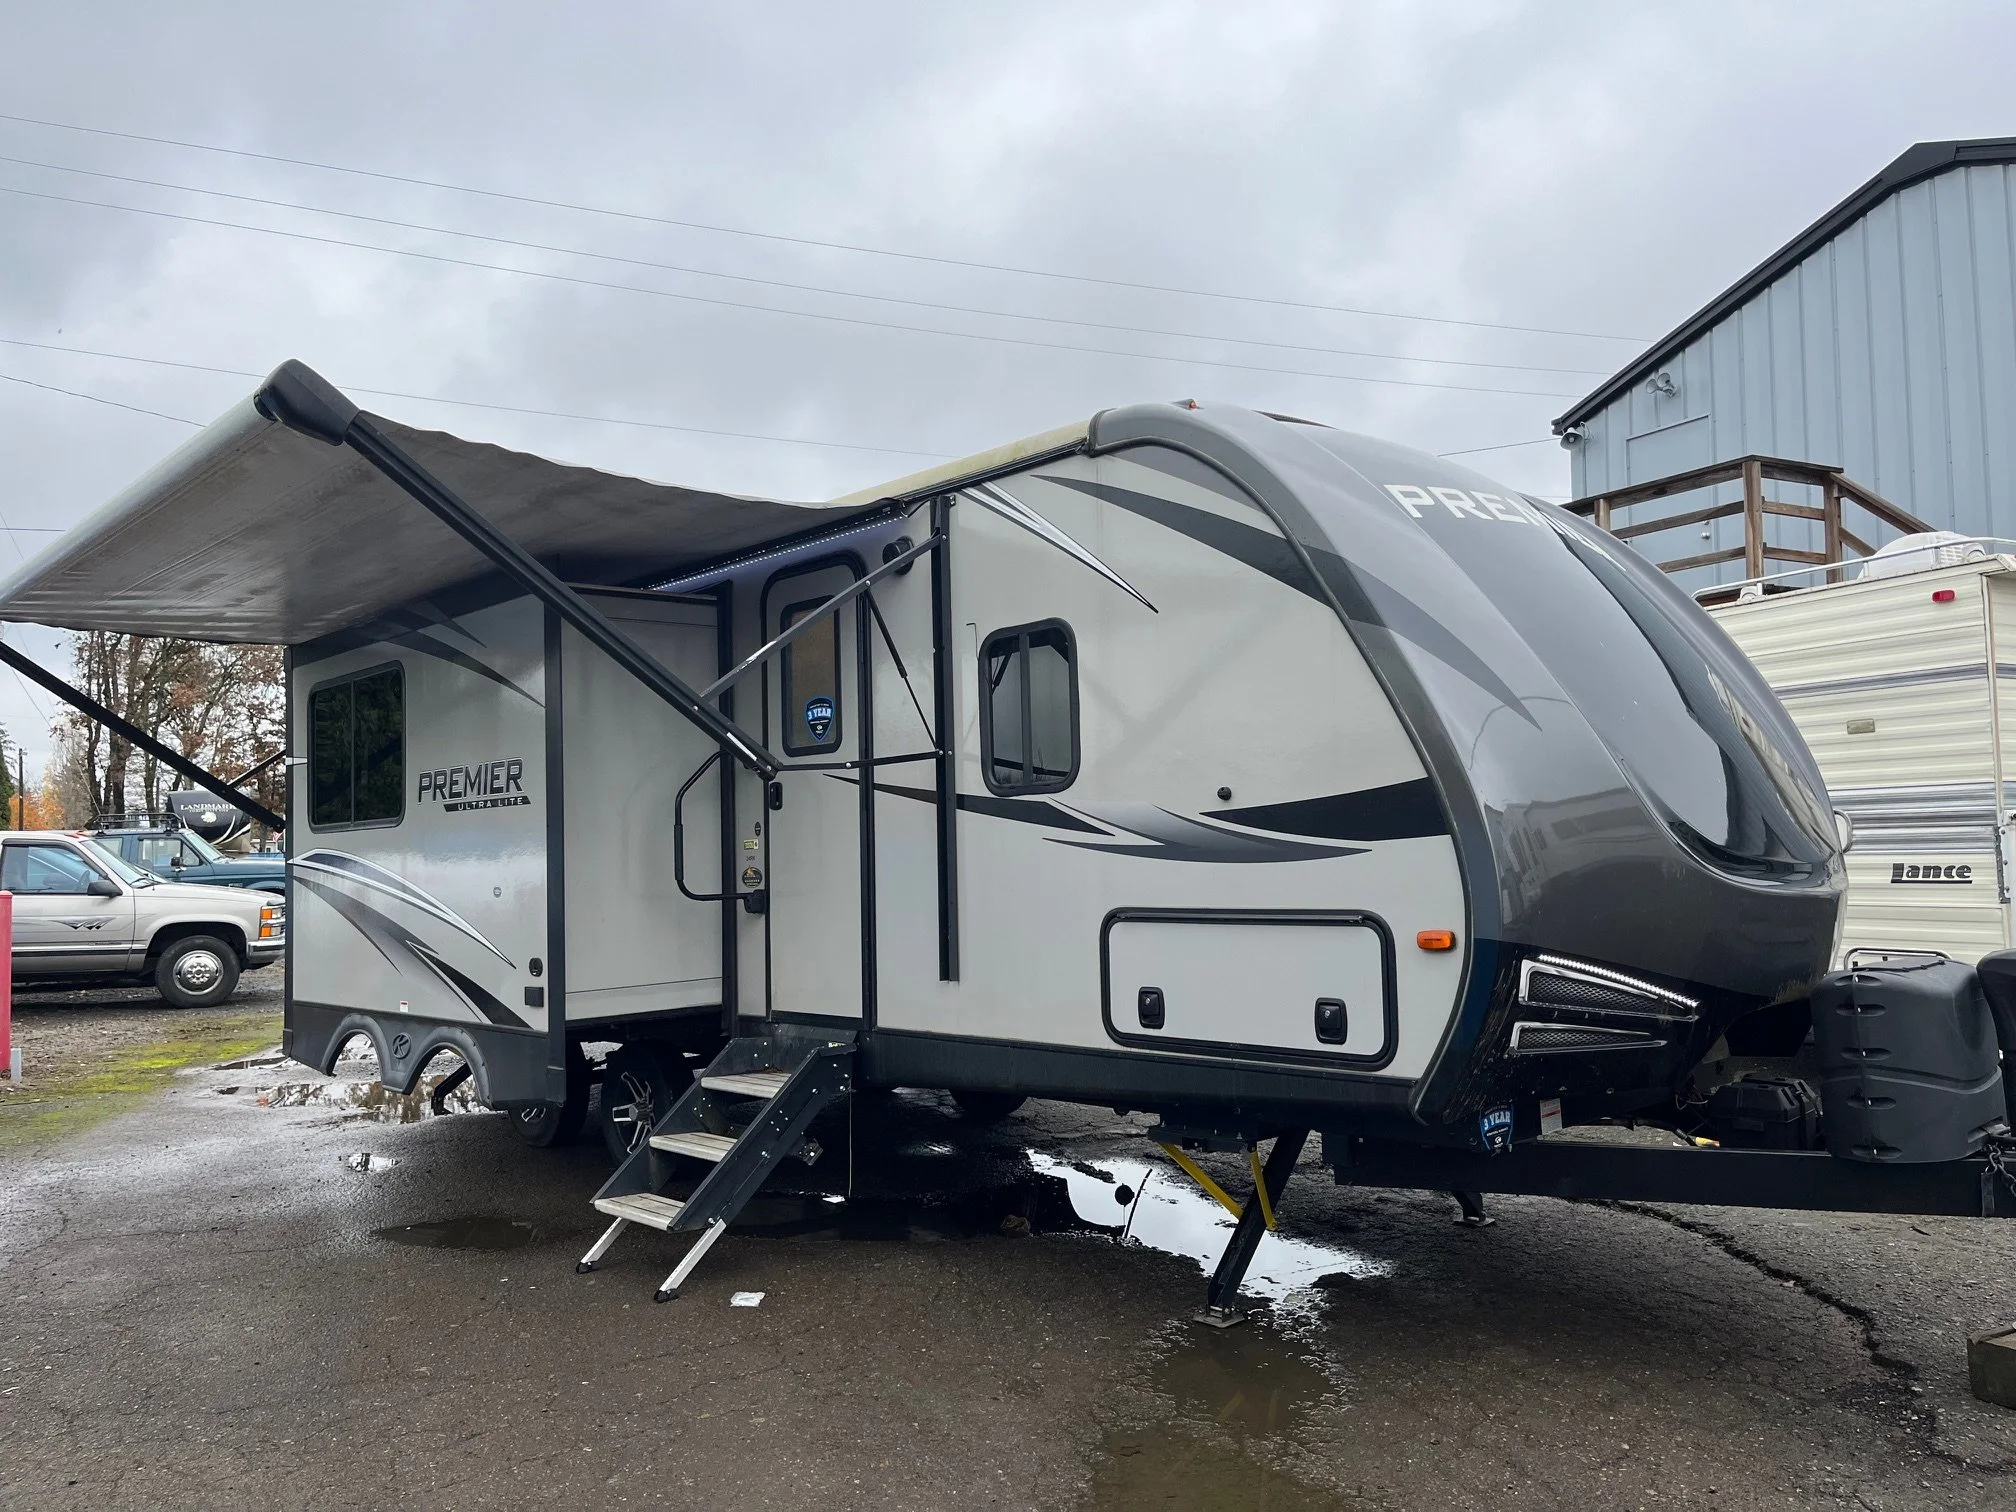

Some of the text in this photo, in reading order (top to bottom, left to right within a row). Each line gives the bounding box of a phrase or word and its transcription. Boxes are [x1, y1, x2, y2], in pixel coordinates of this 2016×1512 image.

[807, 707, 832, 720] 3 YEAR
[418, 757, 524, 805] PREMIER
[458, 797, 523, 811] ULTRA LITE
[1891, 862, 1973, 884] Lance
[1483, 1111, 1511, 1131] 3 YEAR
